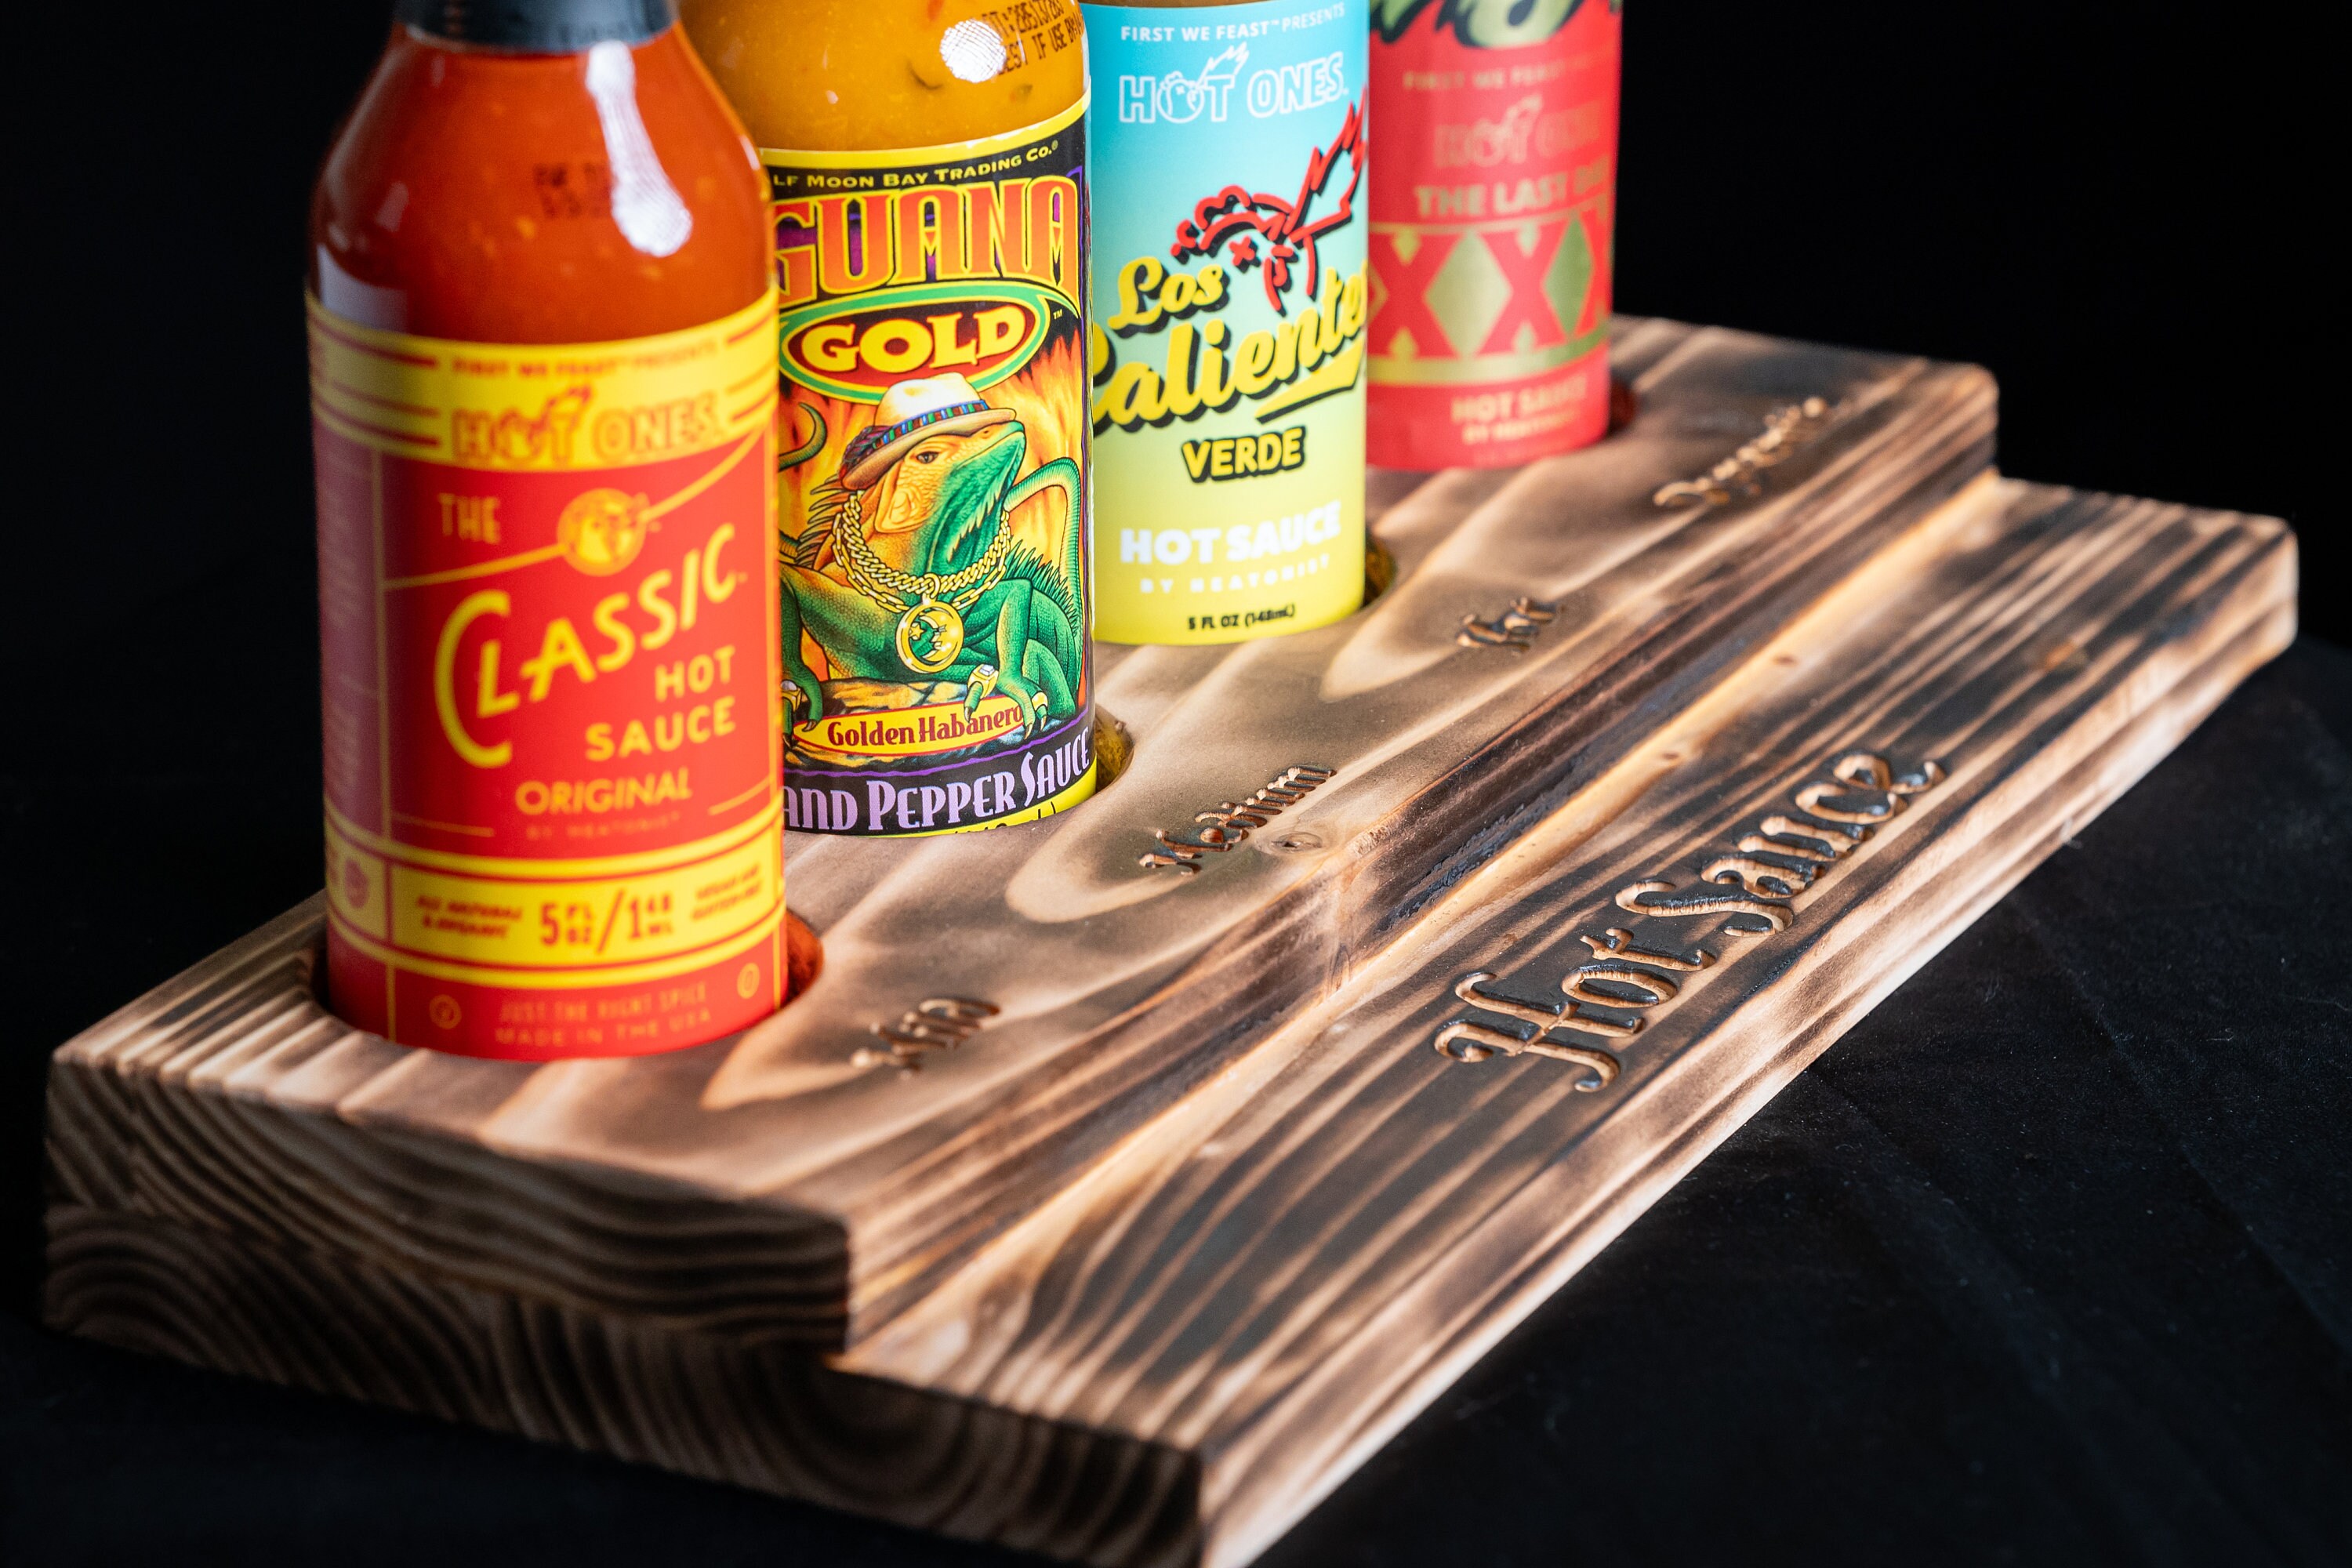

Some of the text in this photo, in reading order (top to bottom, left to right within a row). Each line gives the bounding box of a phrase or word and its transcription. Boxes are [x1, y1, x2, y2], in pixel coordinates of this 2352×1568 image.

[1032, 32, 1046, 60] IF
[1121, 26, 1174, 42] FIRST
[1181, 25, 1210, 42] WE
[1283, 2, 1345, 31] PRESENTS
[1119, 55, 1247, 124] HOT
[773, 174, 797, 187] LF
[1414, 183, 1486, 217] THE
[1494, 172, 1566, 213] LAST
[773, 176, 1080, 317] GUANA
[1107, 256, 1229, 337] Los
[800, 303, 1027, 373] GOLD
[1093, 259, 1367, 431] aliente
[1181, 426, 1306, 483] VERDE
[439, 493, 500, 544] THE
[1120, 499, 1341, 564] HOT SAUCE
[433, 522, 738, 769] CLASSIC
[1202, 616, 1215, 630] FL
[1221, 615, 1240, 628] OZ
[655, 644, 735, 702] HOT
[586, 695, 735, 761] SAUCE
[828, 705, 1024, 749] Golden Habanero
[515, 767, 693, 815] ORIGINAL
[783, 786, 858, 830] AND
[1138, 764, 1337, 875] Medium
[539, 902, 561, 946] 5
[1433, 750, 1947, 1093] Hot Sauce
